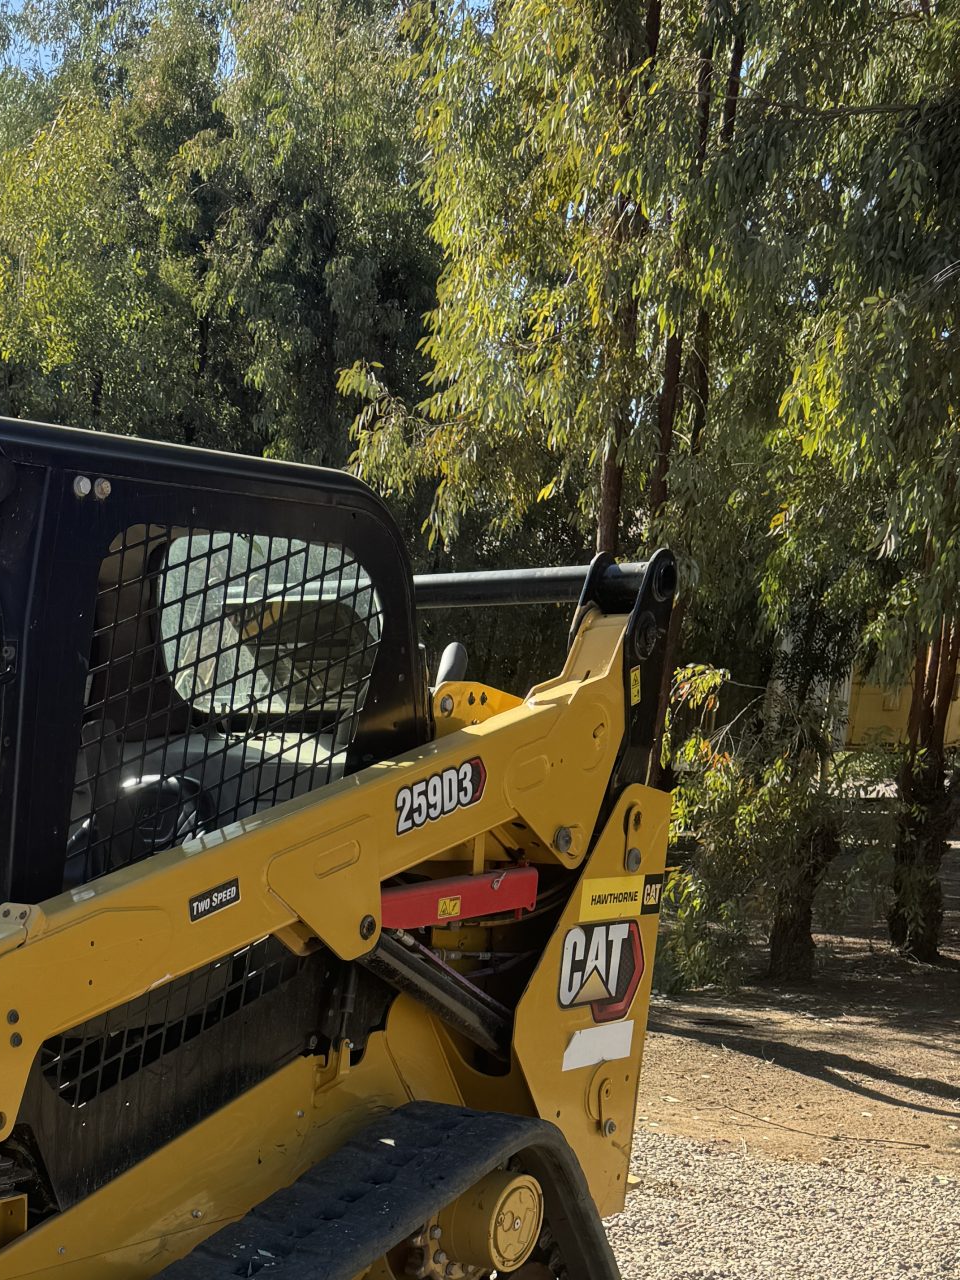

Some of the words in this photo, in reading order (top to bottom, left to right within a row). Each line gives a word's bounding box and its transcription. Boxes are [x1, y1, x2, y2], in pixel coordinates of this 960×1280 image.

[396, 762, 473, 833] 259D3
[590, 891, 639, 906] HAWTHORNE
[643, 883, 661, 905] CAT
[560, 923, 629, 1005] CAT
